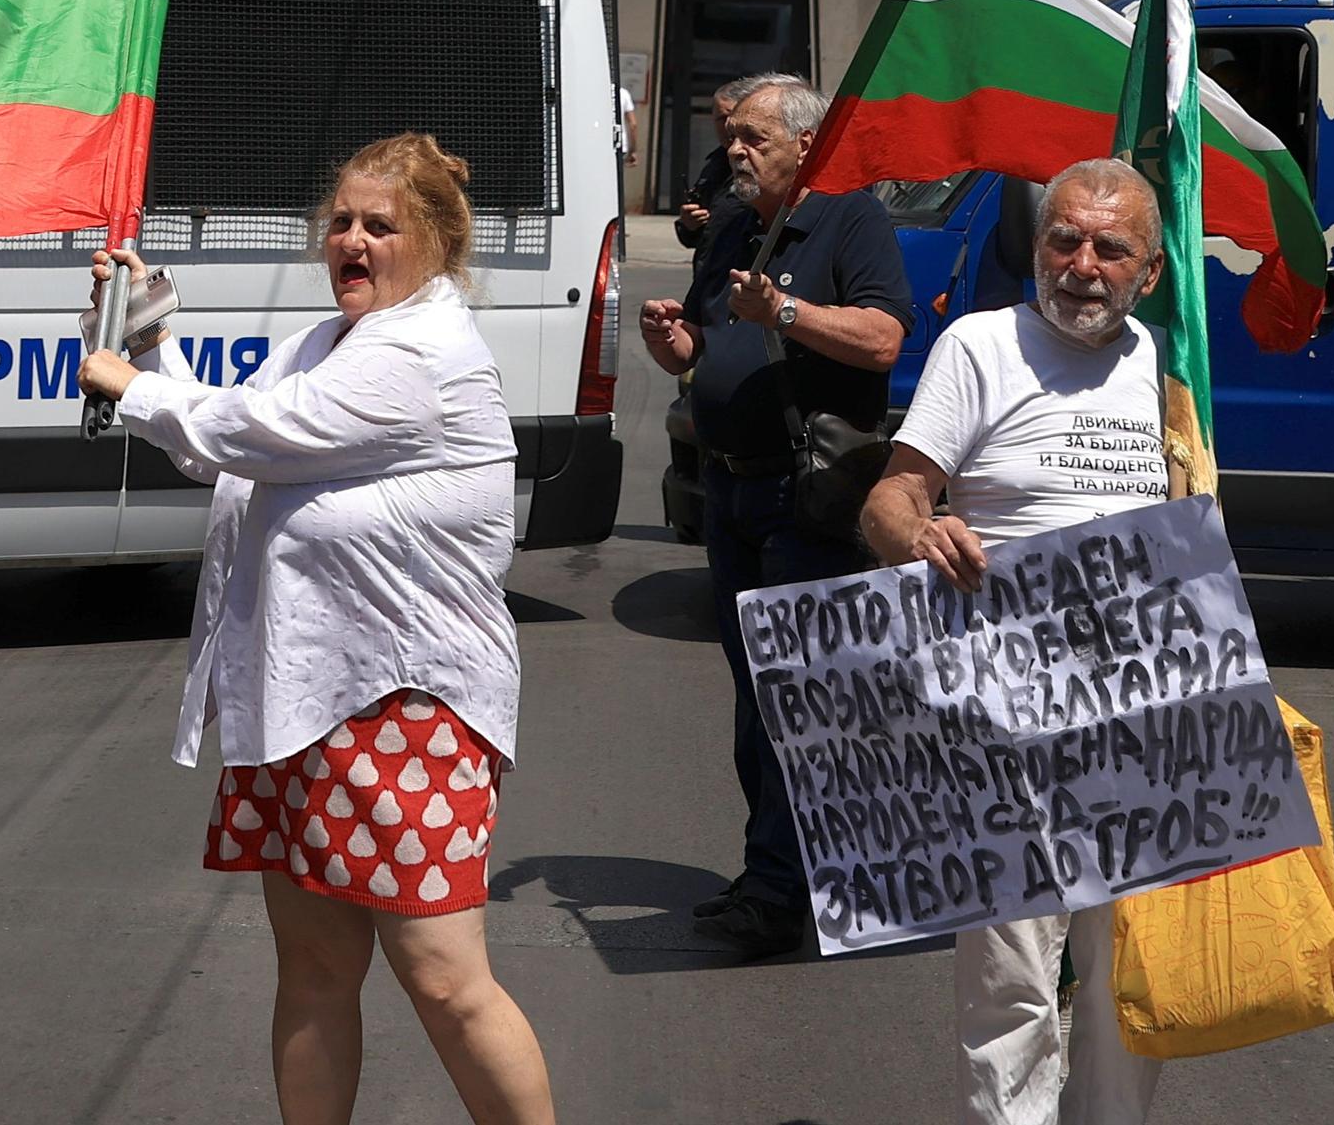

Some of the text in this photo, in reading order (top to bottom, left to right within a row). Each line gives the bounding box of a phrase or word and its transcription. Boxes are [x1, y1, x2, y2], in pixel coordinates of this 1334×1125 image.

[1040, 454, 1052, 467] И
[1064, 434, 1085, 449] ЗА
[1072, 415, 1157, 435] ДВИЖЕНИЕ
[1073, 477, 1168, 498] НА НАРОДА
[741, 582, 891, 667] ЕВРОТО
[932, 642, 966, 696] В
[971, 576, 1204, 697] КОВЧЕГА
[938, 627, 1247, 748] НА БЪЛГАРИЯ
[797, 791, 978, 870] НАРОДЕН
[813, 847, 1005, 940] ЗАТВОР
[1023, 839, 1083, 903] ДО
